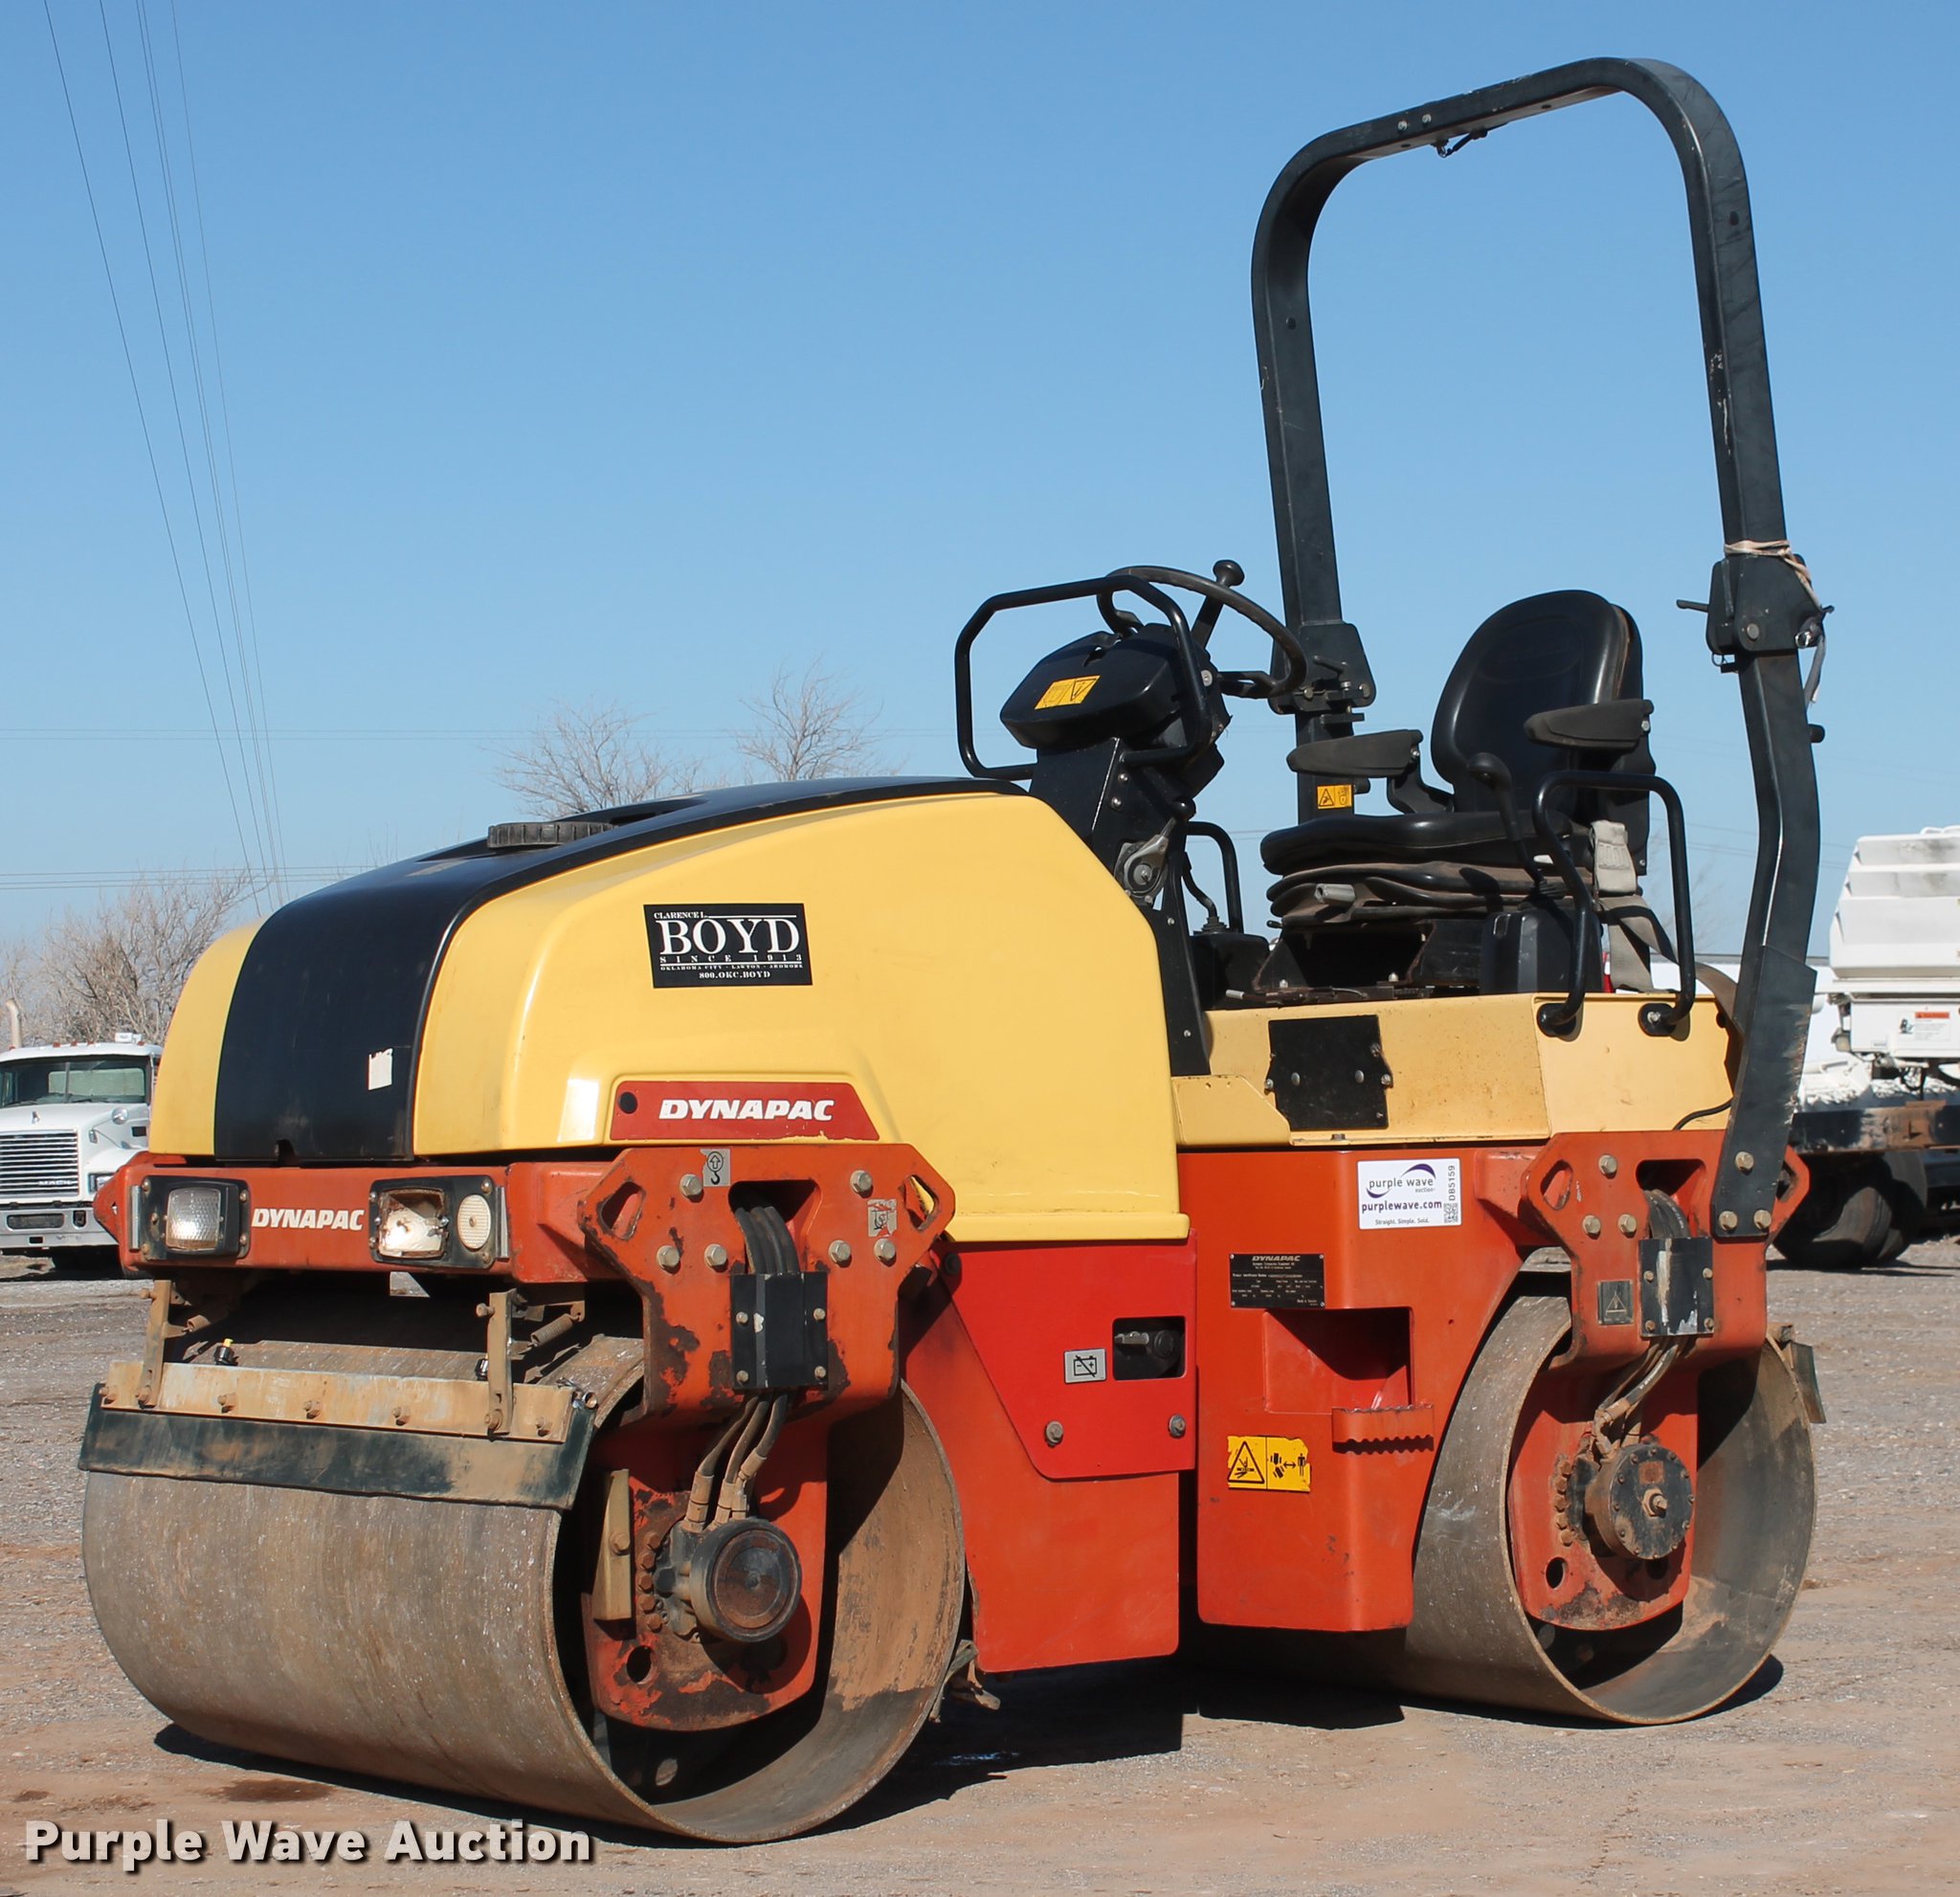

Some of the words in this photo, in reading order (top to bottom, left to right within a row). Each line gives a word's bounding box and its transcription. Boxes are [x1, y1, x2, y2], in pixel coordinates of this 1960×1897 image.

[656, 919, 800, 955] BOYD
[659, 954, 732, 964] SINCE
[699, 971, 771, 979] 800.OKC.BOYD
[658, 1099, 835, 1121] DYNAPAC
[1369, 1177, 1403, 1191] purple
[1406, 1178, 1434, 1187] wave
[1362, 1199, 1442, 1215] purplewave.com
[251, 1208, 365, 1231] DYNAPAC
